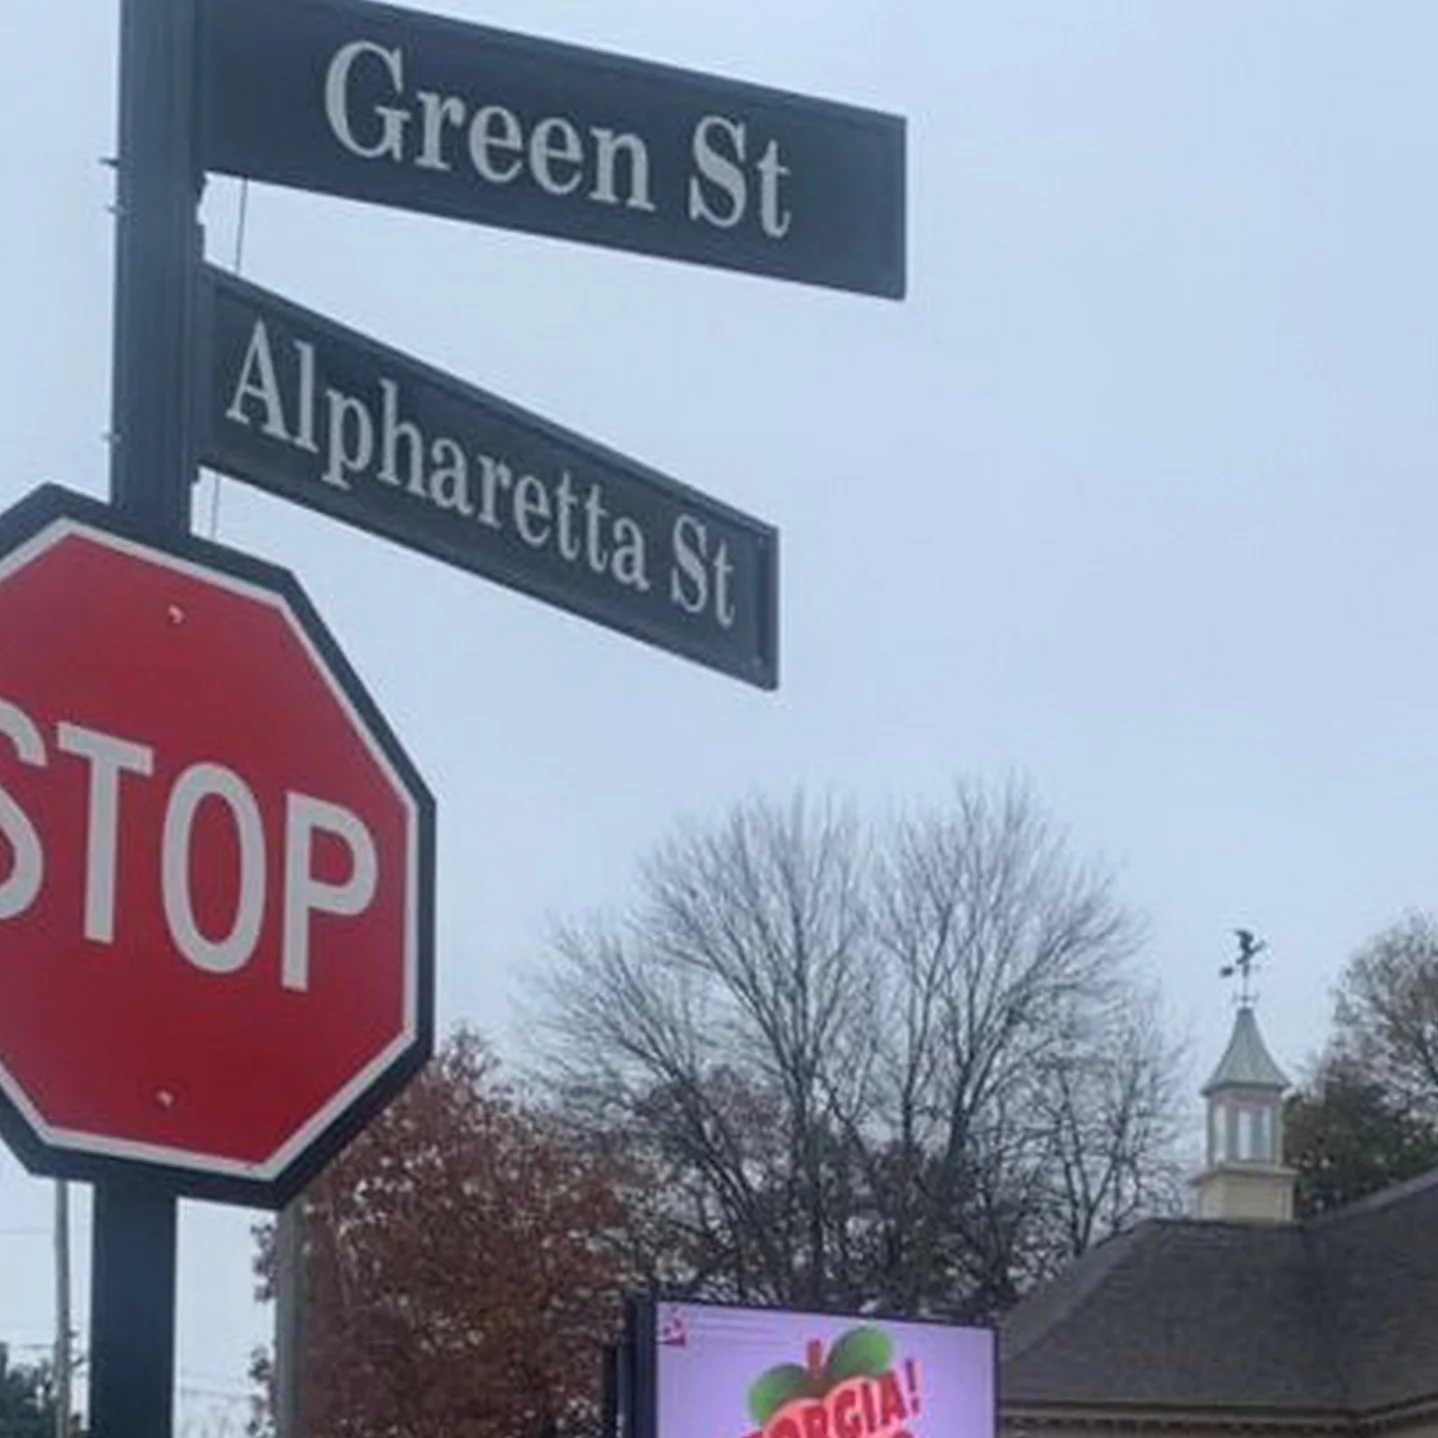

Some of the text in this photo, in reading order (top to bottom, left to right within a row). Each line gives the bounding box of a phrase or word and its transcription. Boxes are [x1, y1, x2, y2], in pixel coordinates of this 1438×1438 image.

[325, 40, 792, 240] Green St
[226, 318, 736, 627] Alpharetta St
[0, 700, 378, 992] STOP
